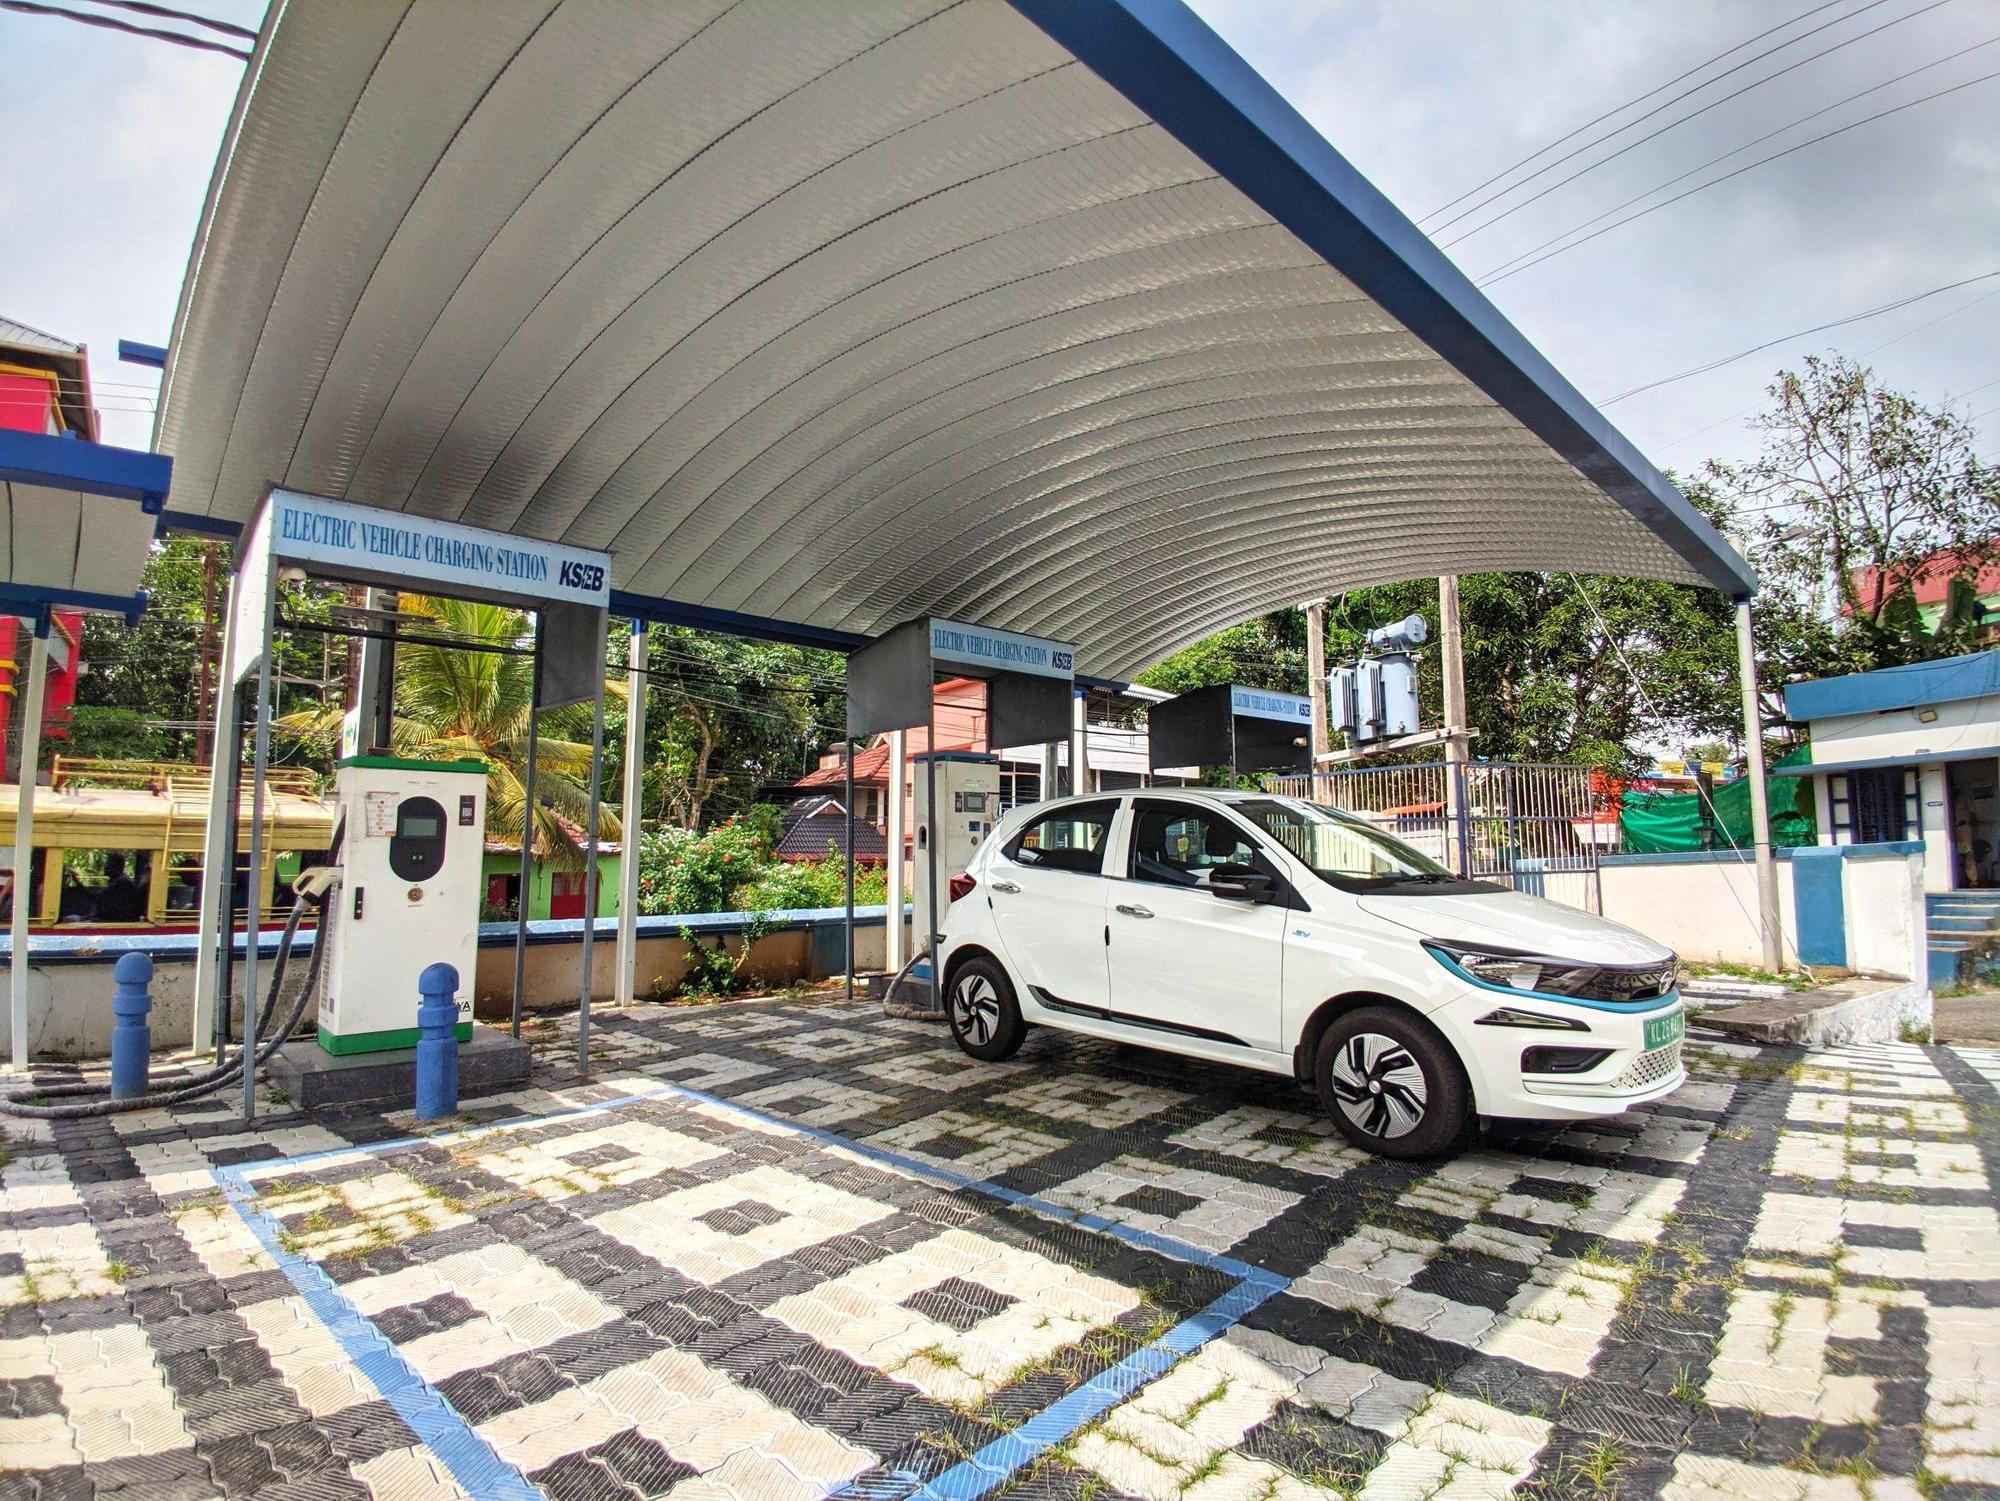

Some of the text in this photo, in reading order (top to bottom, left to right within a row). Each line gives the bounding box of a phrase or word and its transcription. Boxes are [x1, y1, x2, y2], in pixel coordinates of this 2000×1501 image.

[282, 508, 550, 582] ELECTRIC VEHICLE CHARGING STATION
[558, 560, 605, 592] KSEB
[934, 629, 1048, 666] ELECTRIC VEHICLE CHARGING STATION
[1052, 650, 1073, 671] KSEB
